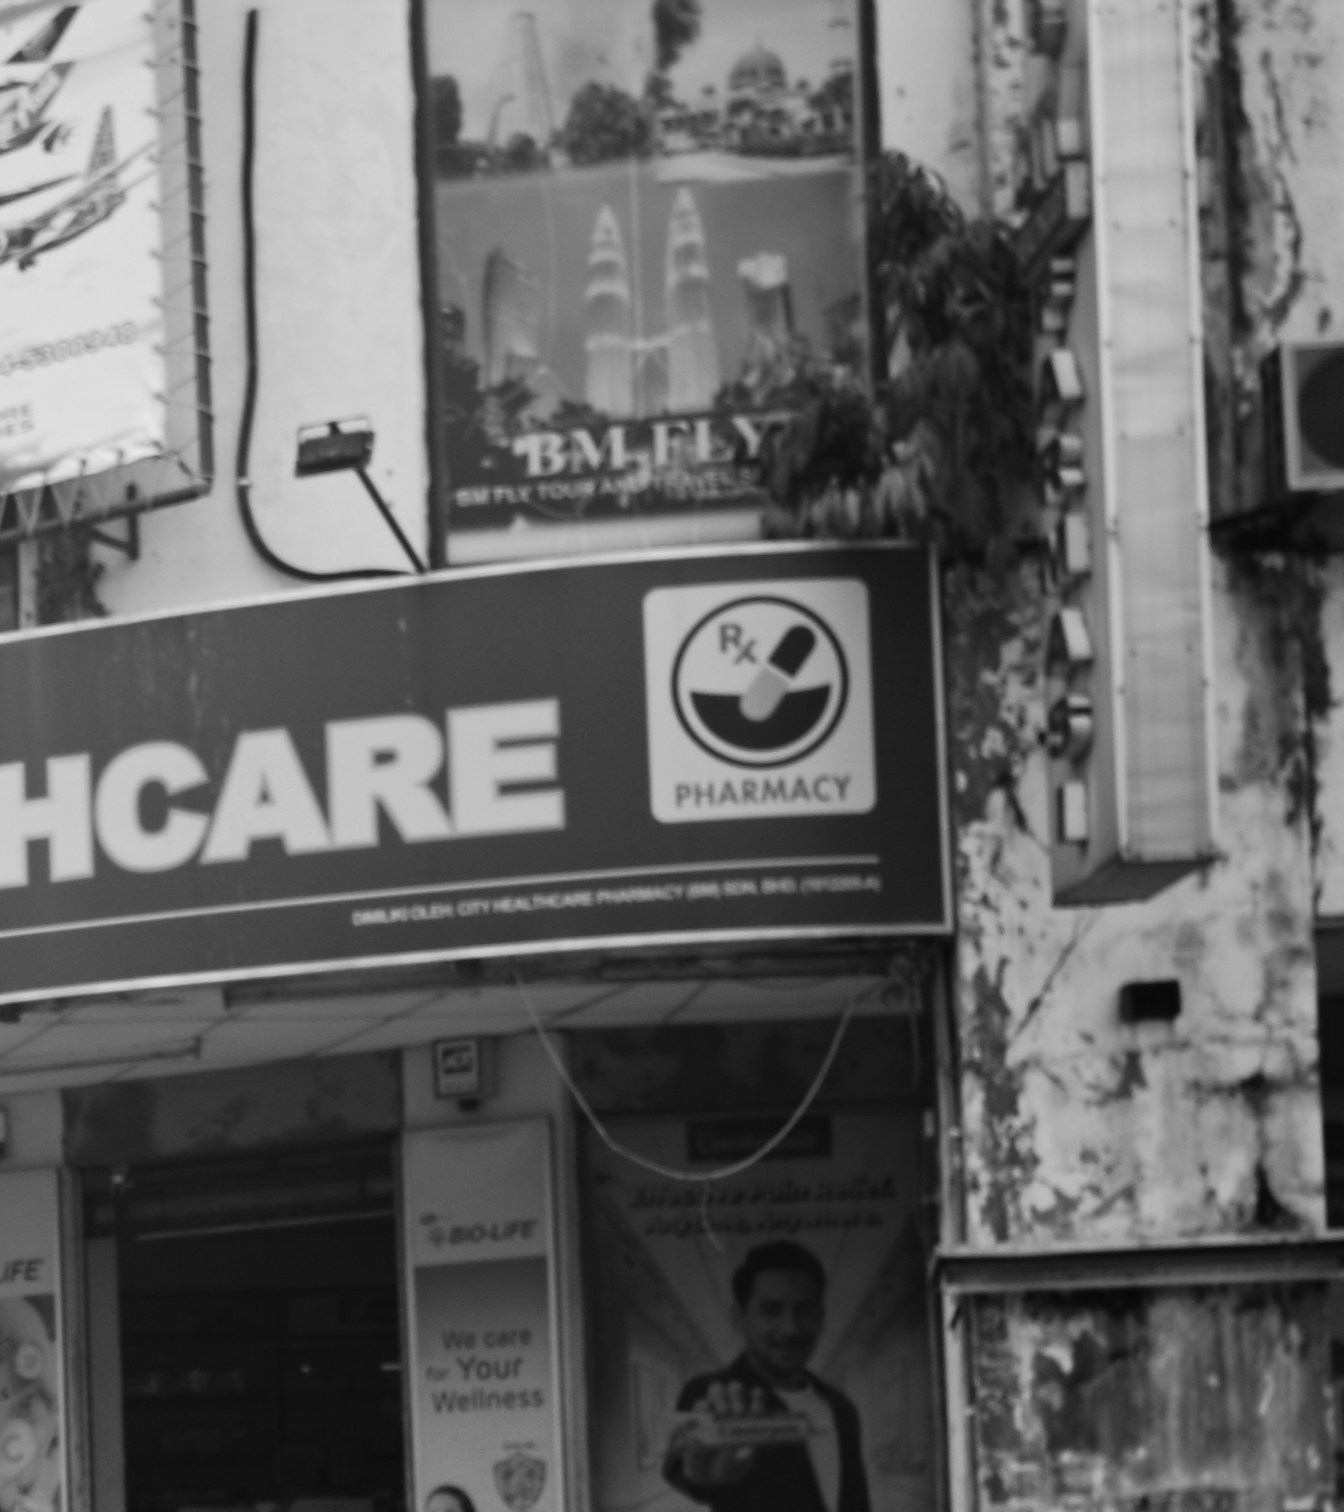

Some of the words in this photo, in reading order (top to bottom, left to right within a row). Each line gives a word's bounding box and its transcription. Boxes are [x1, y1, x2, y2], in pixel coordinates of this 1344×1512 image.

[512, 426, 626, 478] BM
[652, 416, 762, 468] FLY
[674, 774, 852, 810] PHARMACY
[456, 899, 490, 917] CITY
[493, 890, 592, 915] HEALTHCARE
[595, 883, 684, 905] PHARMACY
[442, 1330, 475, 1350] We
[483, 1329, 532, 1348] care
[456, 1356, 522, 1381] Your
[432, 1388, 544, 1413] Wellness
